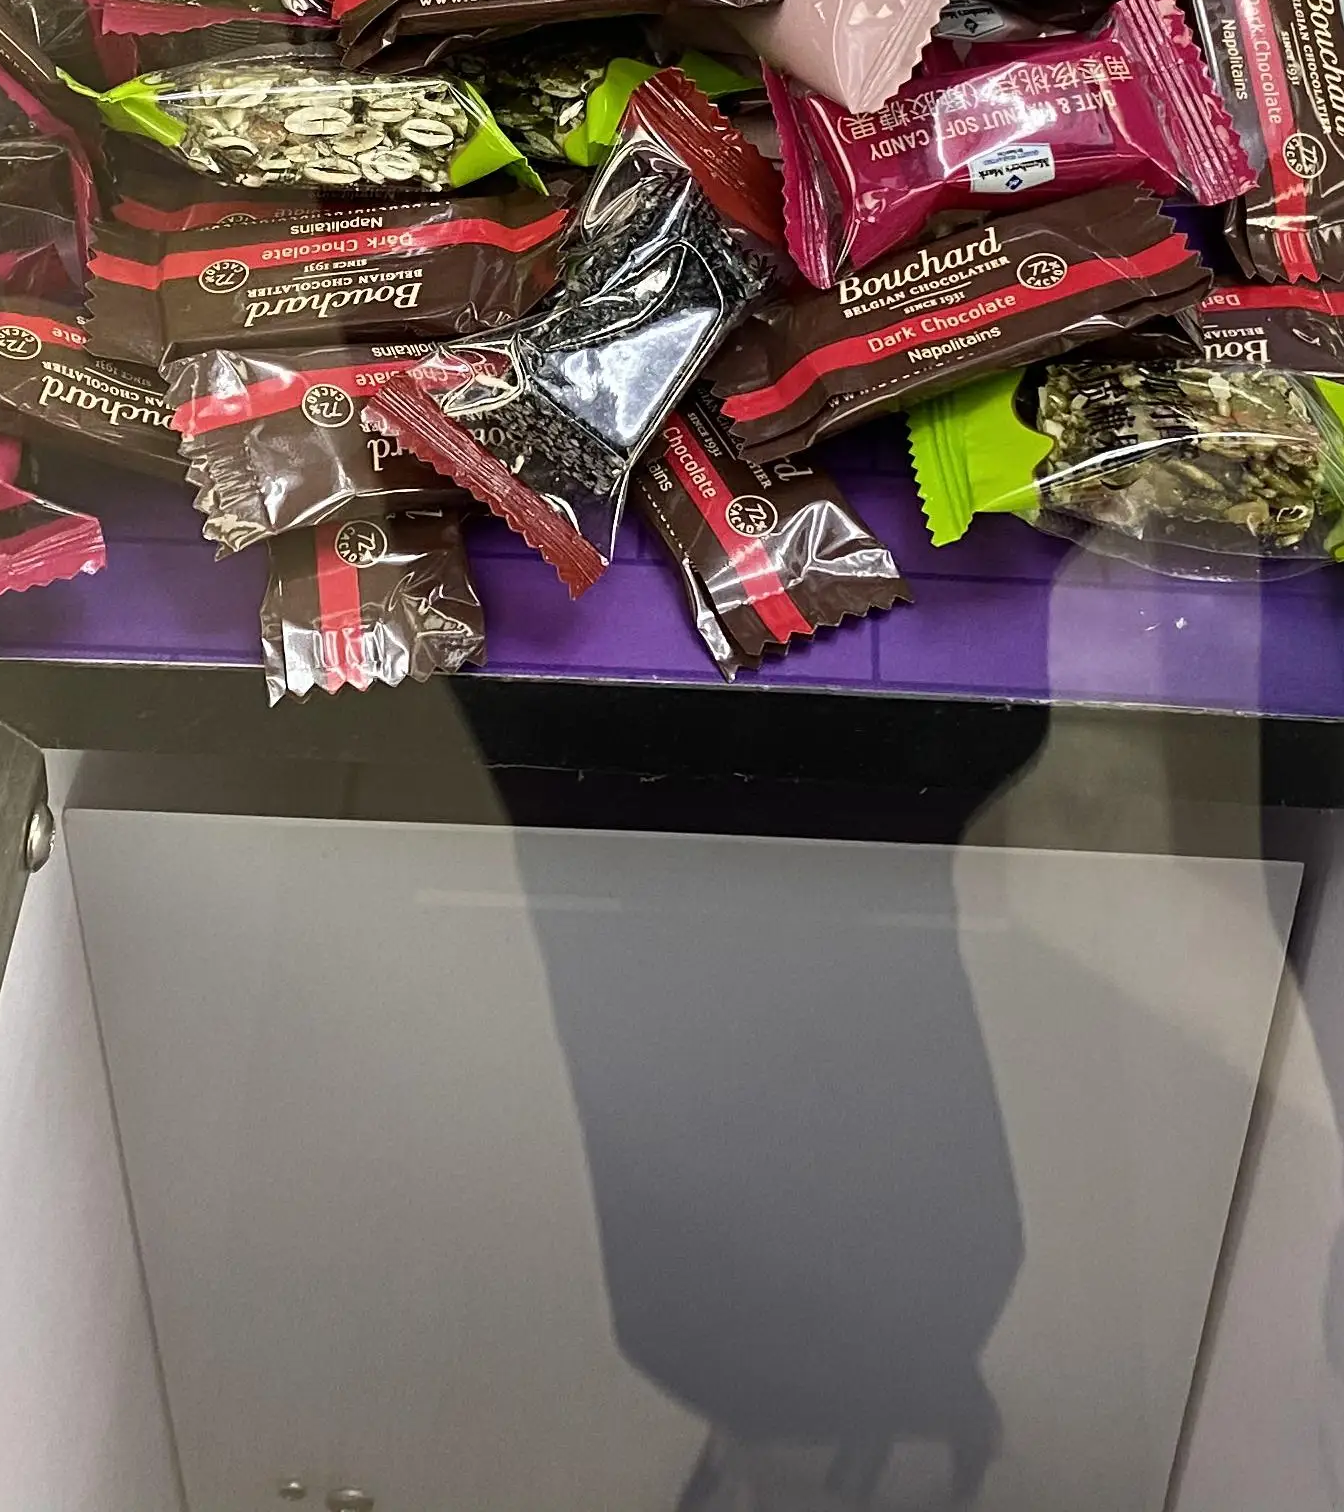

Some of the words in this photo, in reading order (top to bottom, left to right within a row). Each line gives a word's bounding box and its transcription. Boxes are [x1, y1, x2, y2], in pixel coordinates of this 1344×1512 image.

[1220, 19, 1249, 102] Napolitains
[1074, 90, 1119, 116] DATE
[1253, 41, 1283, 125] Chocolate
[1303, 43, 1333, 135] CHOCOLATIER
[869, 125, 931, 162] CANDY
[261, 239, 359, 261] Chocolate
[366, 231, 415, 249] Dark
[290, 215, 384, 236] Napolitains
[358, 268, 424, 284] BELGIAN
[835, 227, 1002, 305] Bouchard
[243, 282, 424, 328] Bouchard
[247, 276, 354, 299] CHOCOLATIER
[842, 291, 906, 320] BELGIAN
[909, 256, 1012, 296] CHOCOLATIER
[904, 299, 938, 315] SINCE
[940, 291, 966, 304] 1931
[867, 326, 917, 354] Dark
[920, 294, 1017, 335] Chocolate
[907, 324, 1002, 364] Napolitains
[42, 360, 142, 402] CHOCOLATIER
[662, 426, 717, 499] Chocolate
